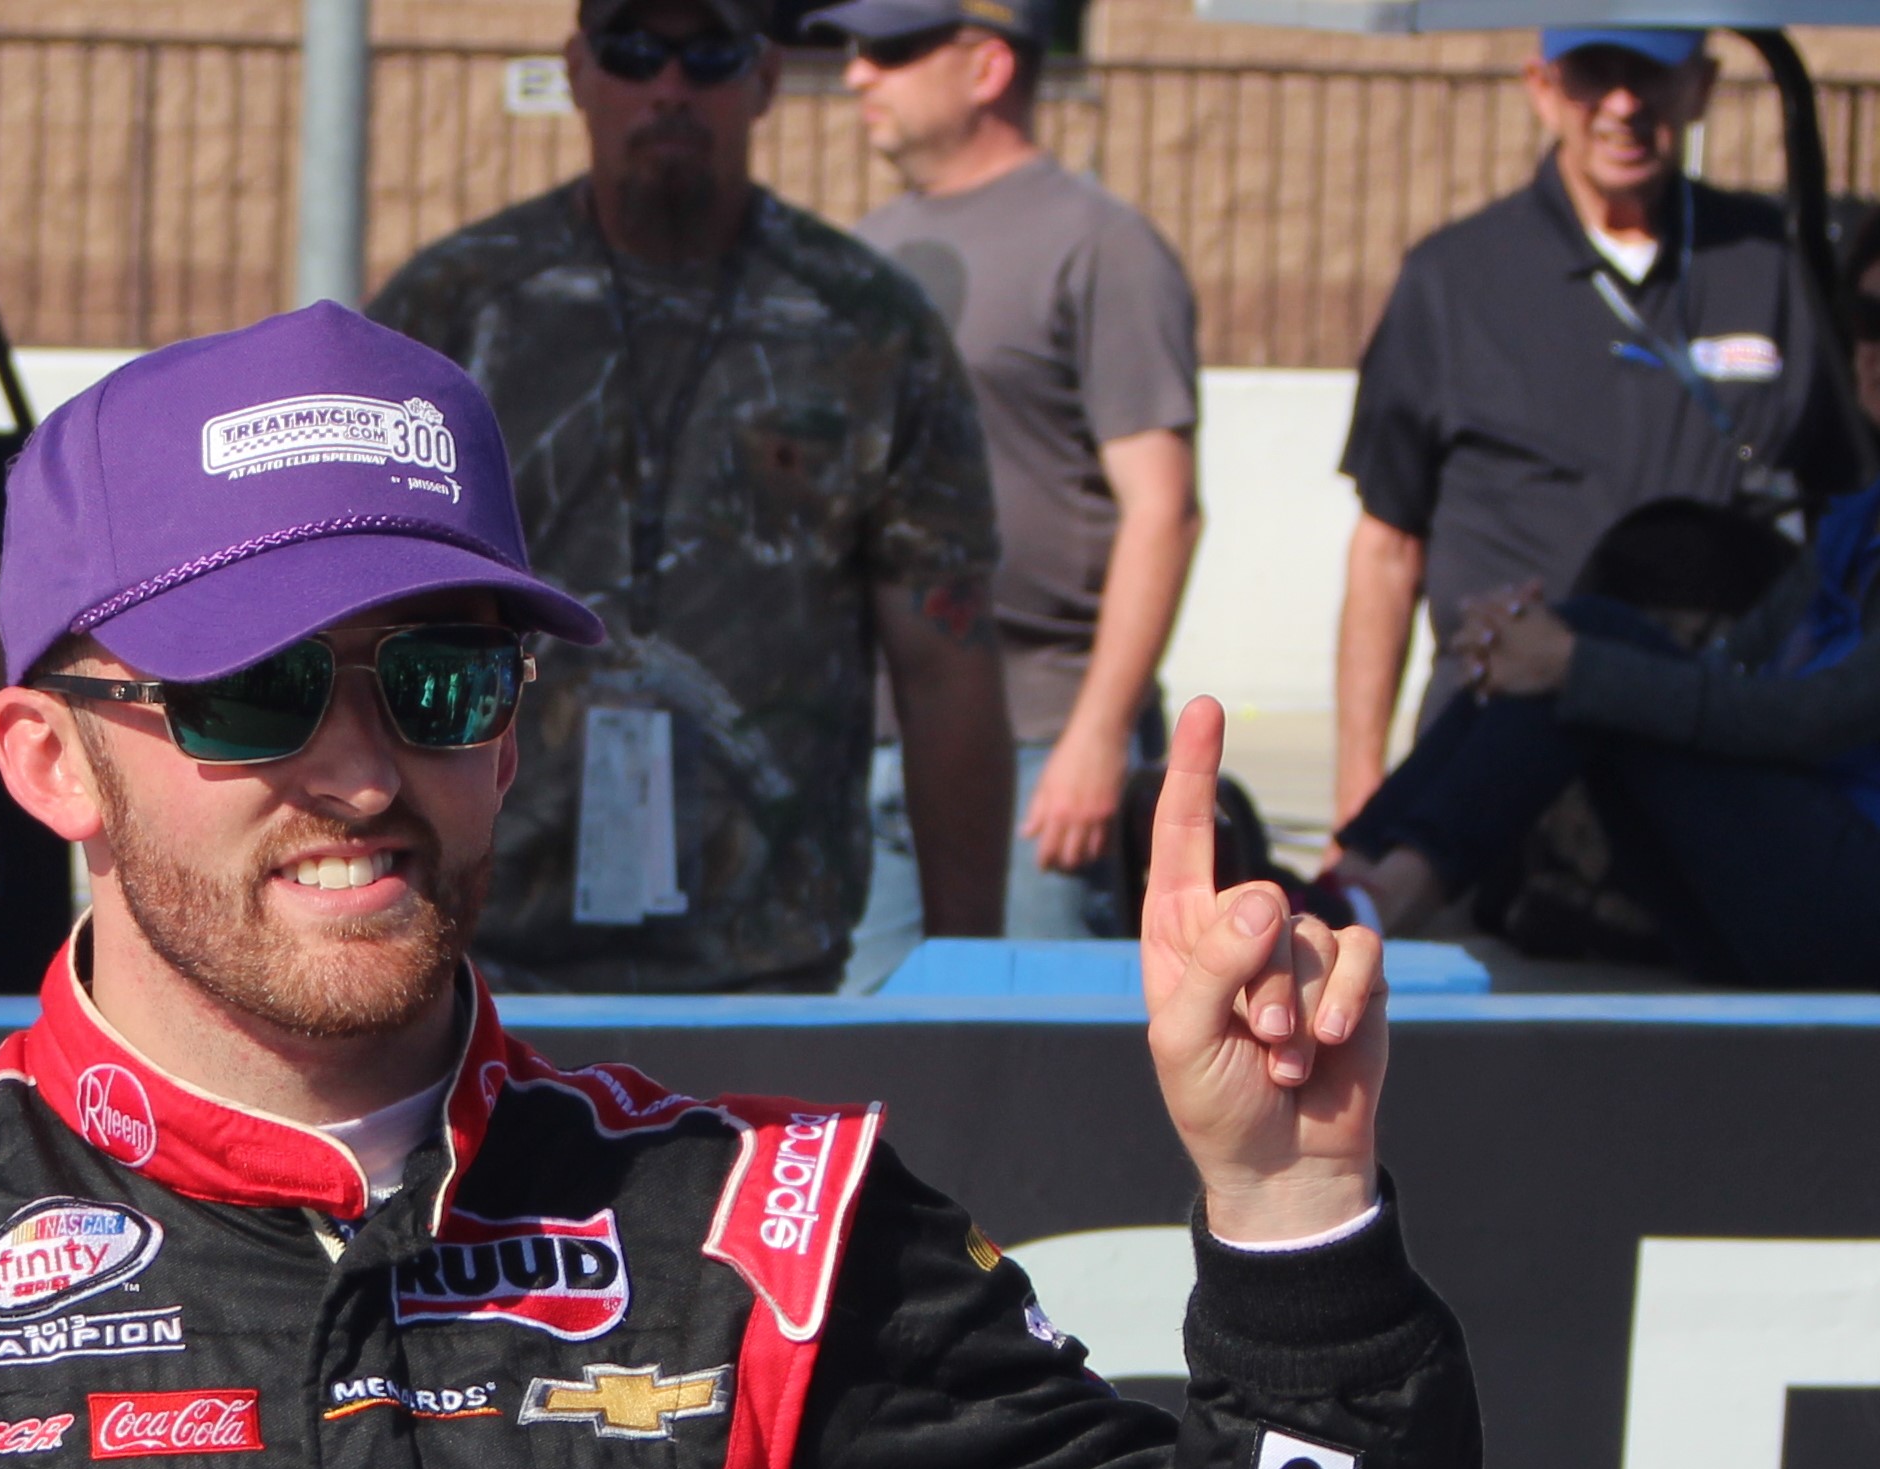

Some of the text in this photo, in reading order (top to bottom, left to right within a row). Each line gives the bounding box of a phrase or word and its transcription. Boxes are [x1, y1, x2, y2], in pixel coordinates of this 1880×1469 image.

[222, 409, 383, 443] TREATMYCLOT
[344, 427, 387, 443] .COM
[393, 419, 451, 469] 300
[228, 452, 388, 480] AT AUTO CLUB SPEEDWAY
[407, 476, 450, 495] janssen
[83, 1071, 149, 1152] Rheem
[761, 1113, 839, 1254] sparco
[42, 1213, 119, 1238] NASCAR
[397, 1238, 619, 1296] RUUD
[23, 1315, 87, 1339] 2013
